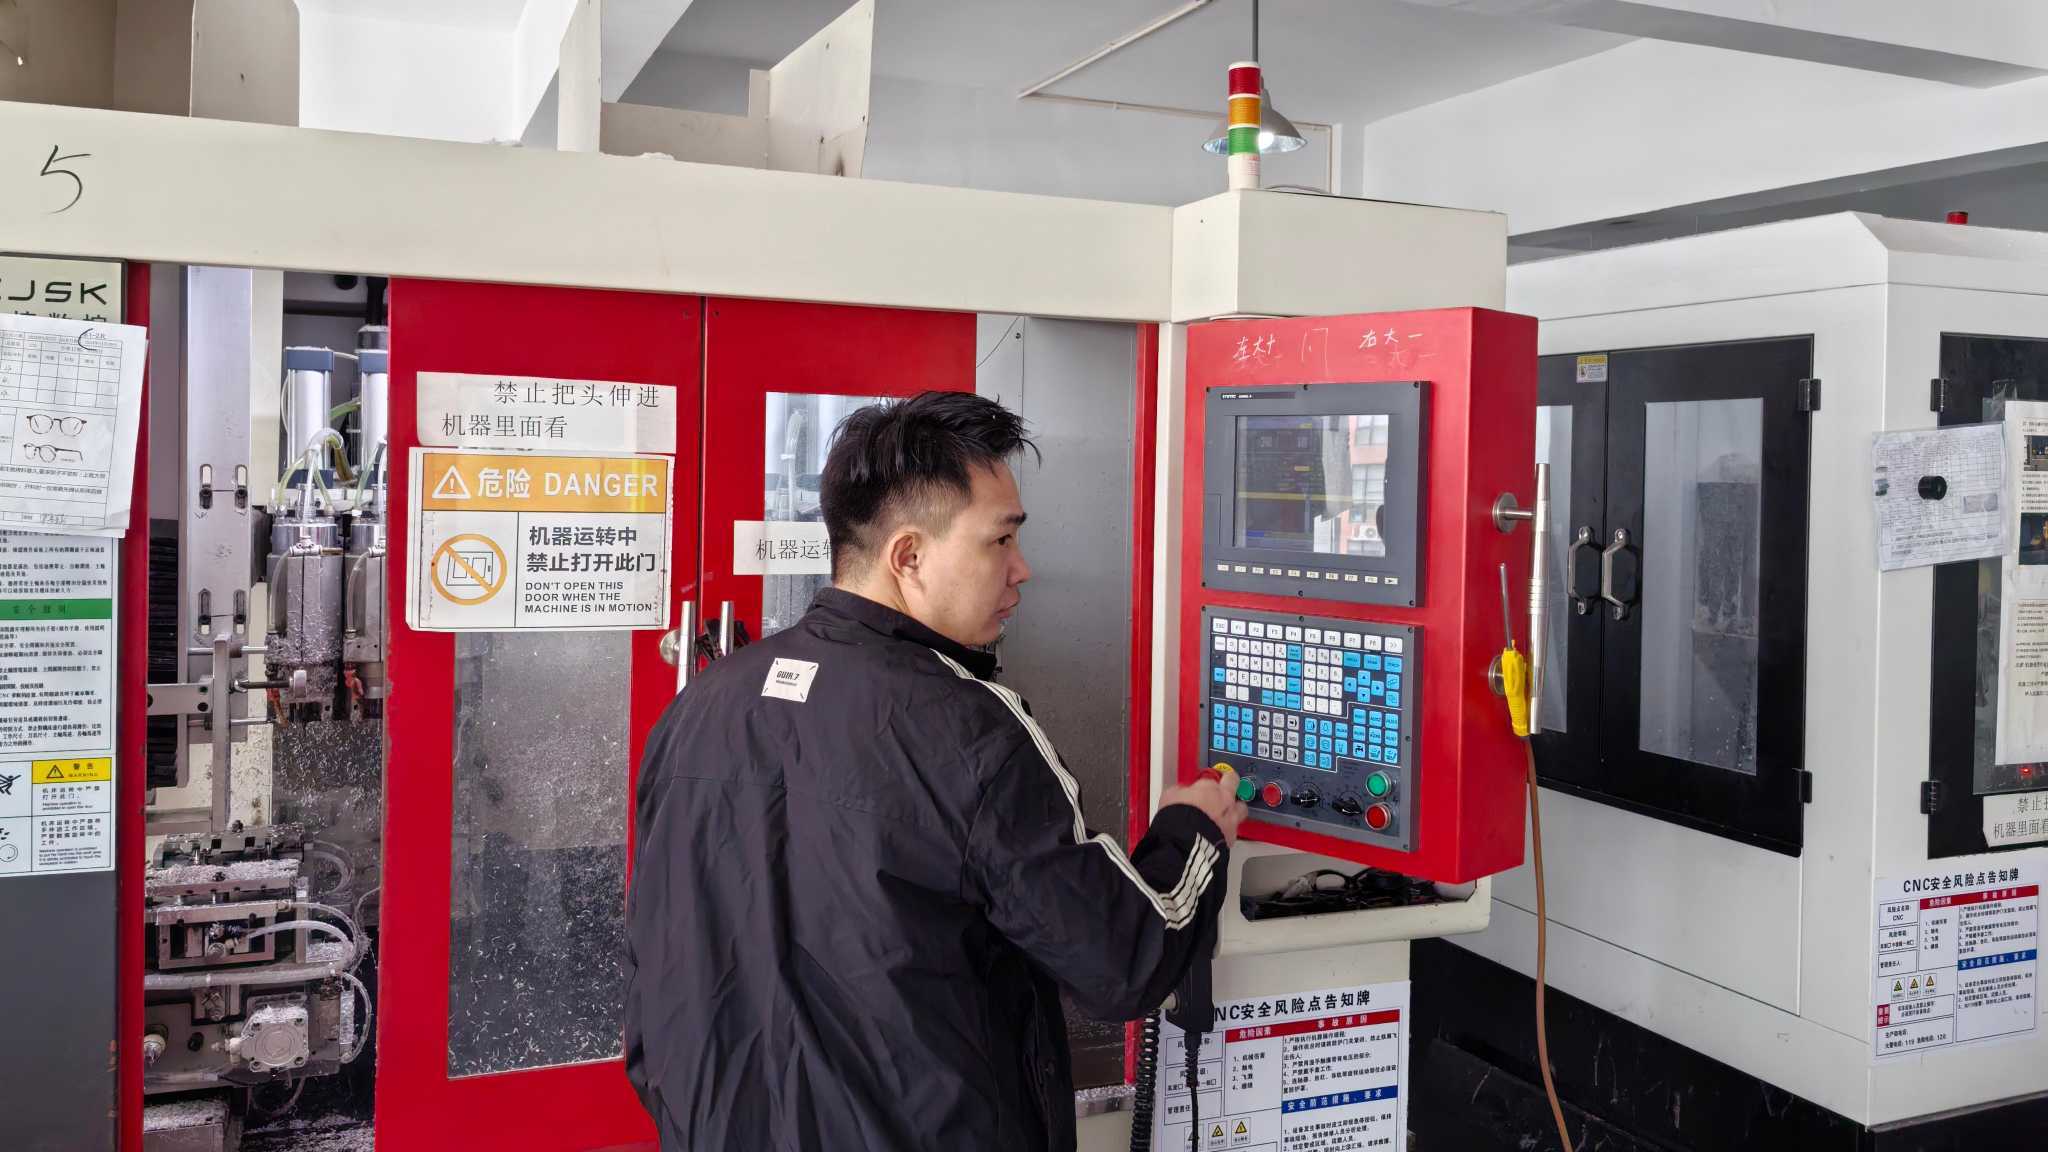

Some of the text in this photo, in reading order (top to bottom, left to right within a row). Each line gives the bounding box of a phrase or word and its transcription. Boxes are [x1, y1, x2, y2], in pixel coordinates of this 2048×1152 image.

[40, 144, 92, 215] 5
[0, 279, 107, 306] JSK
[493, 380, 660, 409] 禁止把头伸进
[441, 412, 568, 440] 机器里面看
[477, 466, 659, 498] 危险 DANGER
[529, 525, 637, 547] 机器运转中
[526, 552, 656, 573] 禁止打开此门
[525, 581, 624, 591] DON'T OPEN THIS
[525, 592, 621, 602] DOOR WHEN THE
[524, 603, 652, 613] MACHINE IS IN MOTION
[1903, 867, 2019, 893] CNC安全风险点告知牌
[1213, 989, 1371, 1023] NC安全风险点告知牌
